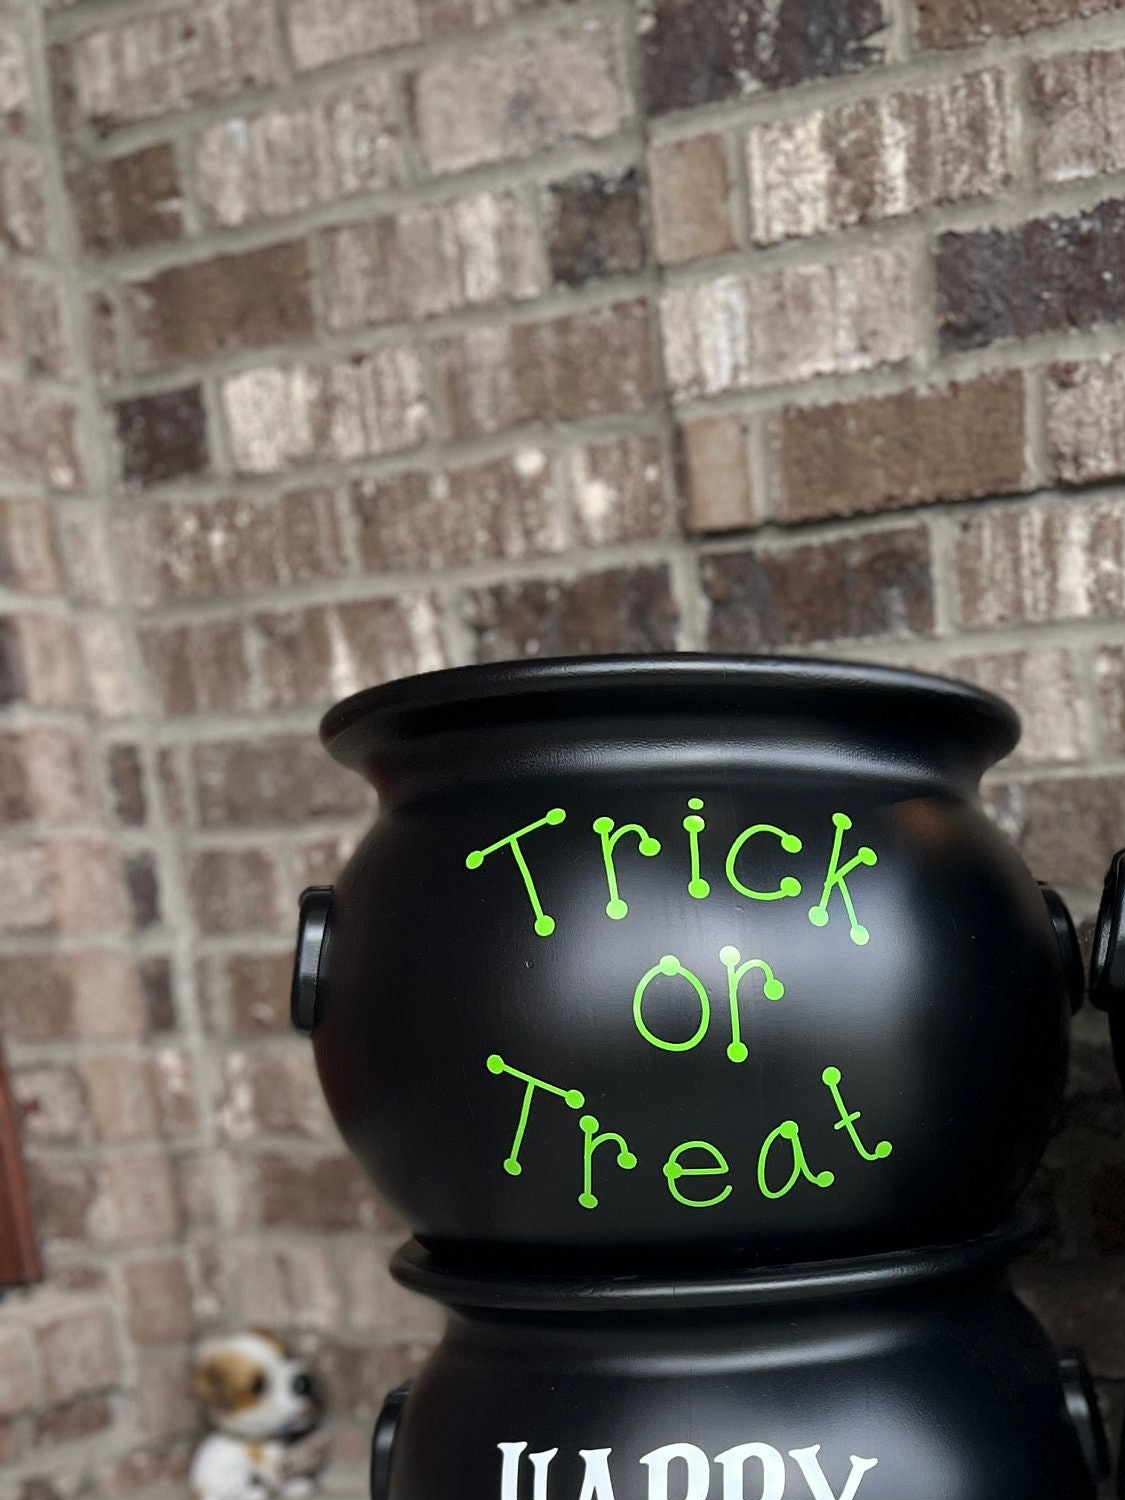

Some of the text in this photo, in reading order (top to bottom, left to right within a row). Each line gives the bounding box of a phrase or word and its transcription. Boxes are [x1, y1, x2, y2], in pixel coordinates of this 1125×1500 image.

[466, 798, 878, 945] Trick
[633, 946, 785, 1063] or
[487, 1055, 892, 1208] Treat
